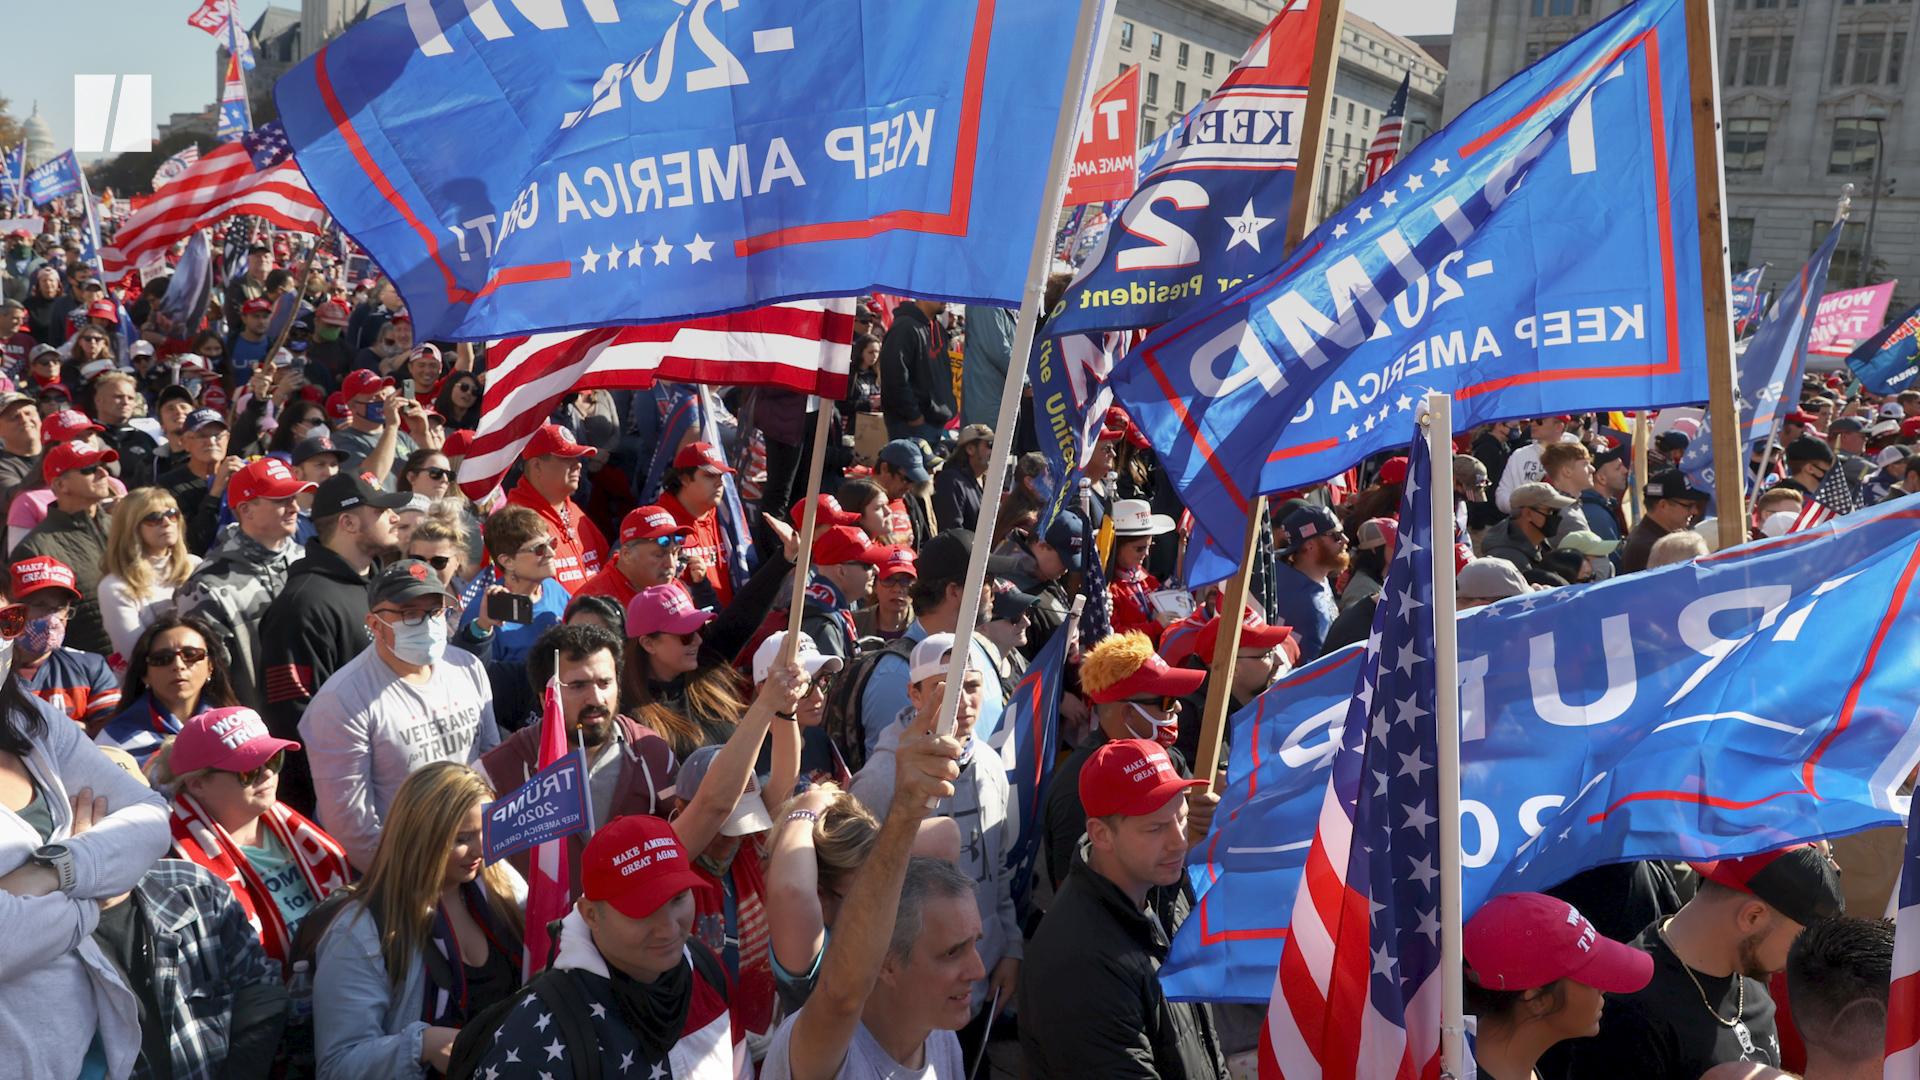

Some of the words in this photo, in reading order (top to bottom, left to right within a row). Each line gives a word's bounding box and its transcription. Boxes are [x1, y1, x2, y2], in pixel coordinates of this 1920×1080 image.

[399, 707, 478, 746] VETERANS
[419, 724, 480, 763] TRUMP
[1123, 758, 1146, 774] MAKE
[1133, 766, 1157, 783] GREAT
[612, 846, 641, 866] MAKE
[621, 855, 652, 877] GREAT
[656, 849, 679, 862] AGAIN
